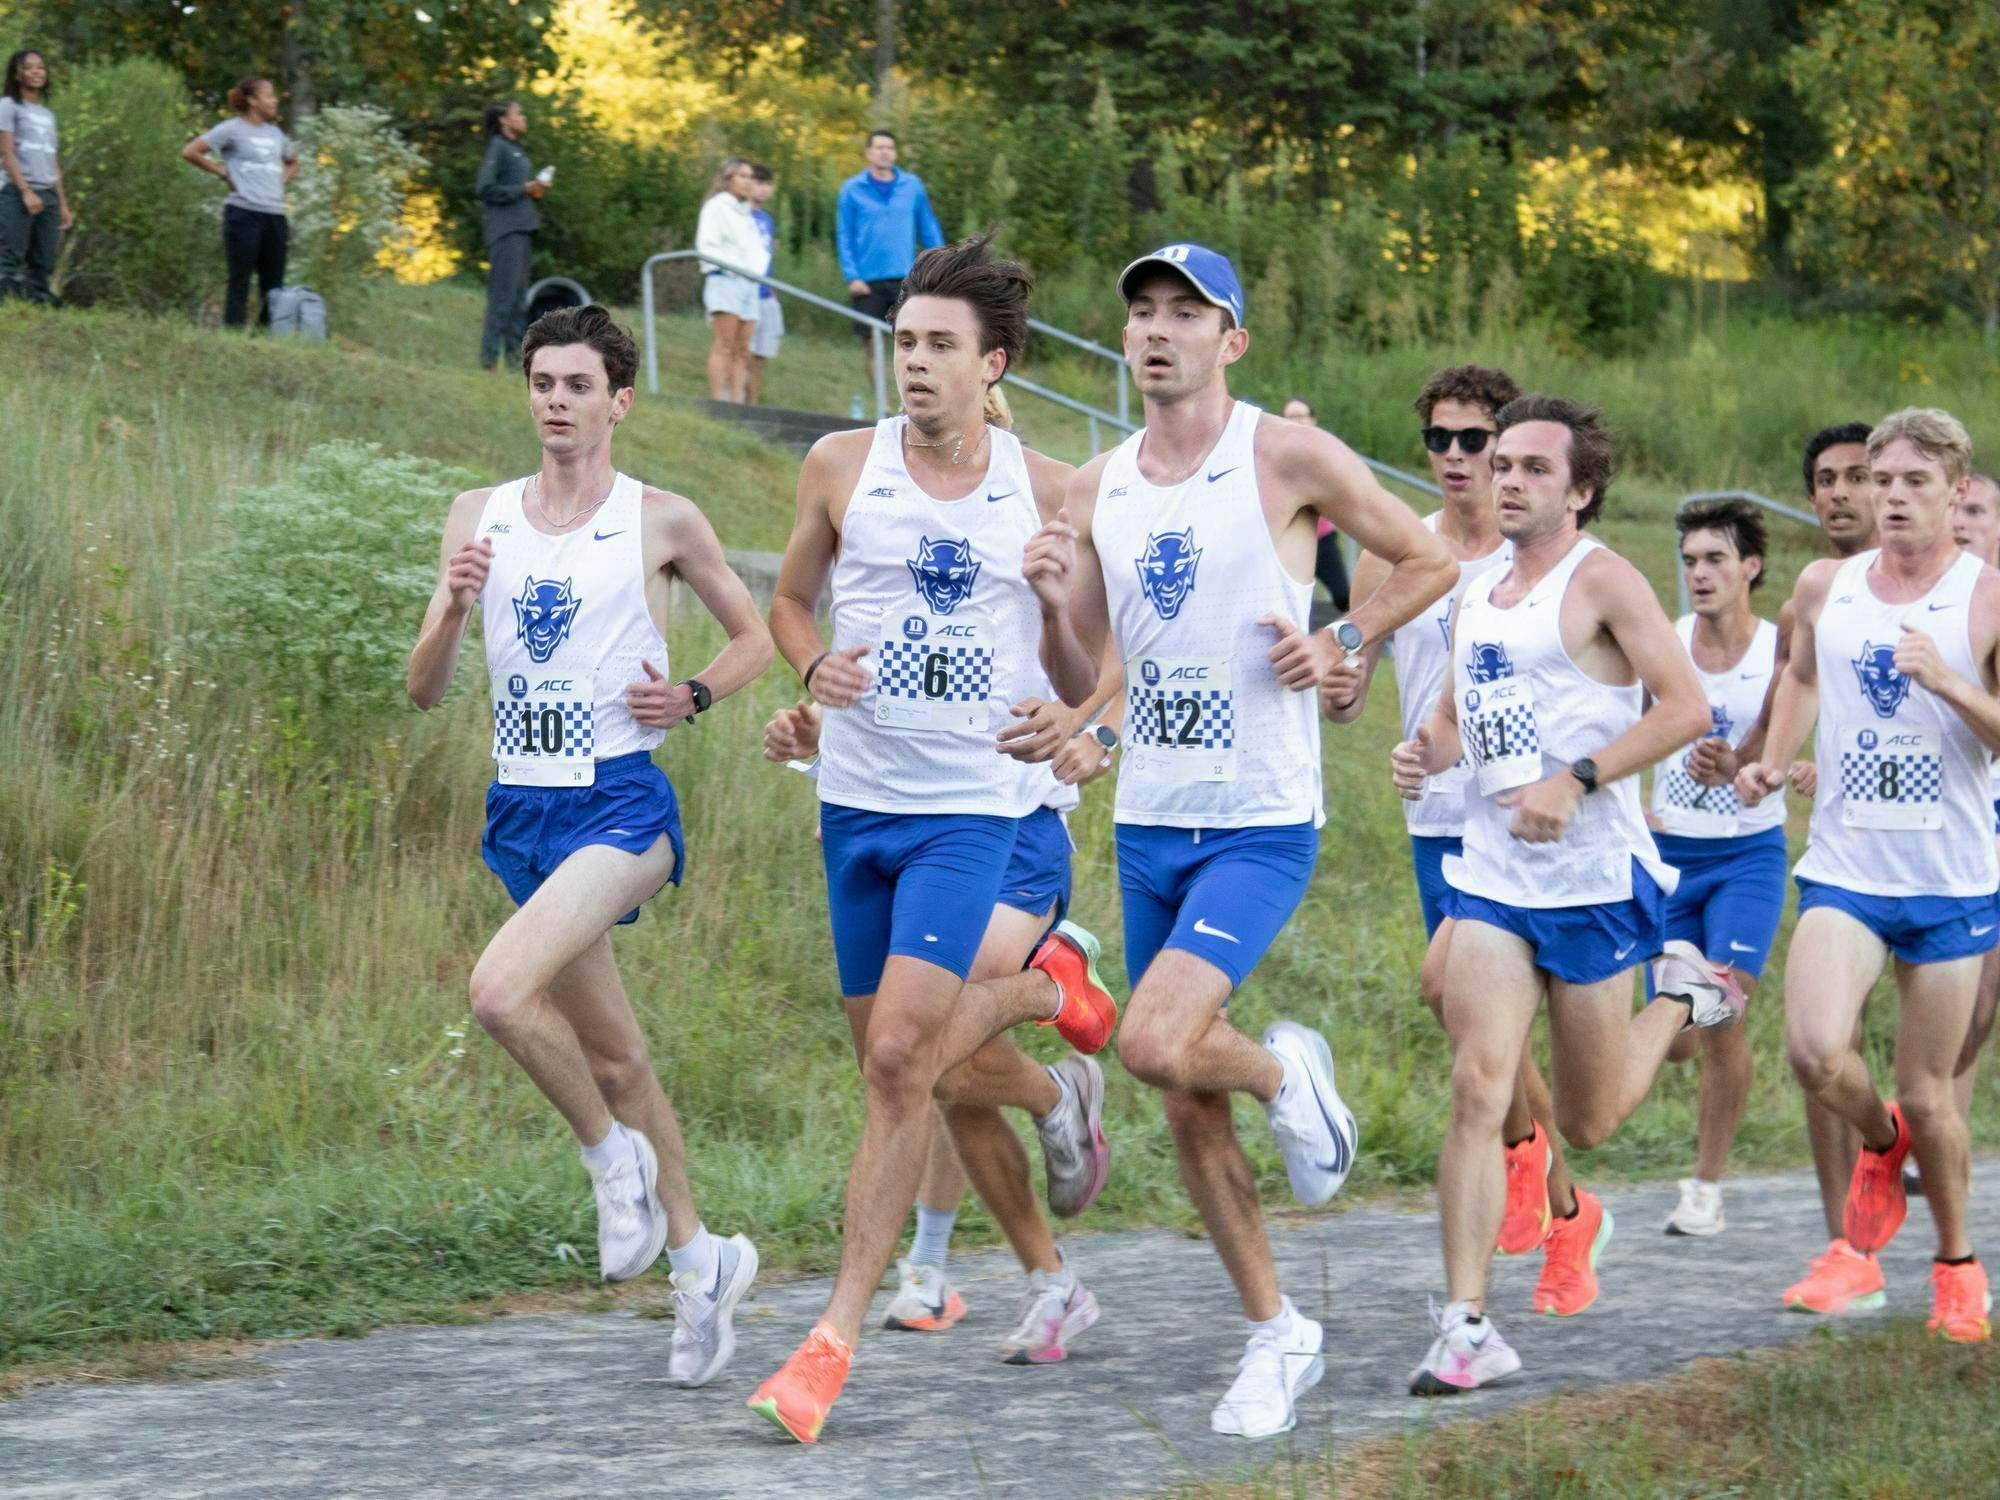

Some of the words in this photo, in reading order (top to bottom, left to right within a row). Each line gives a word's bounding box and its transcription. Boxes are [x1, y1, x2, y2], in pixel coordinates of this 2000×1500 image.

[935, 625, 977, 636] ACC
[534, 680, 574, 691] ACC
[924, 653, 949, 698] 6
[1167, 667, 1208, 679] ACC
[1489, 685, 1517, 700] ACC
[521, 709, 563, 754] 10
[1154, 698, 1203, 745] 12
[1478, 716, 1511, 761] 11
[1886, 735, 1922, 746] ACC
[1878, 761, 1899, 800] 8
